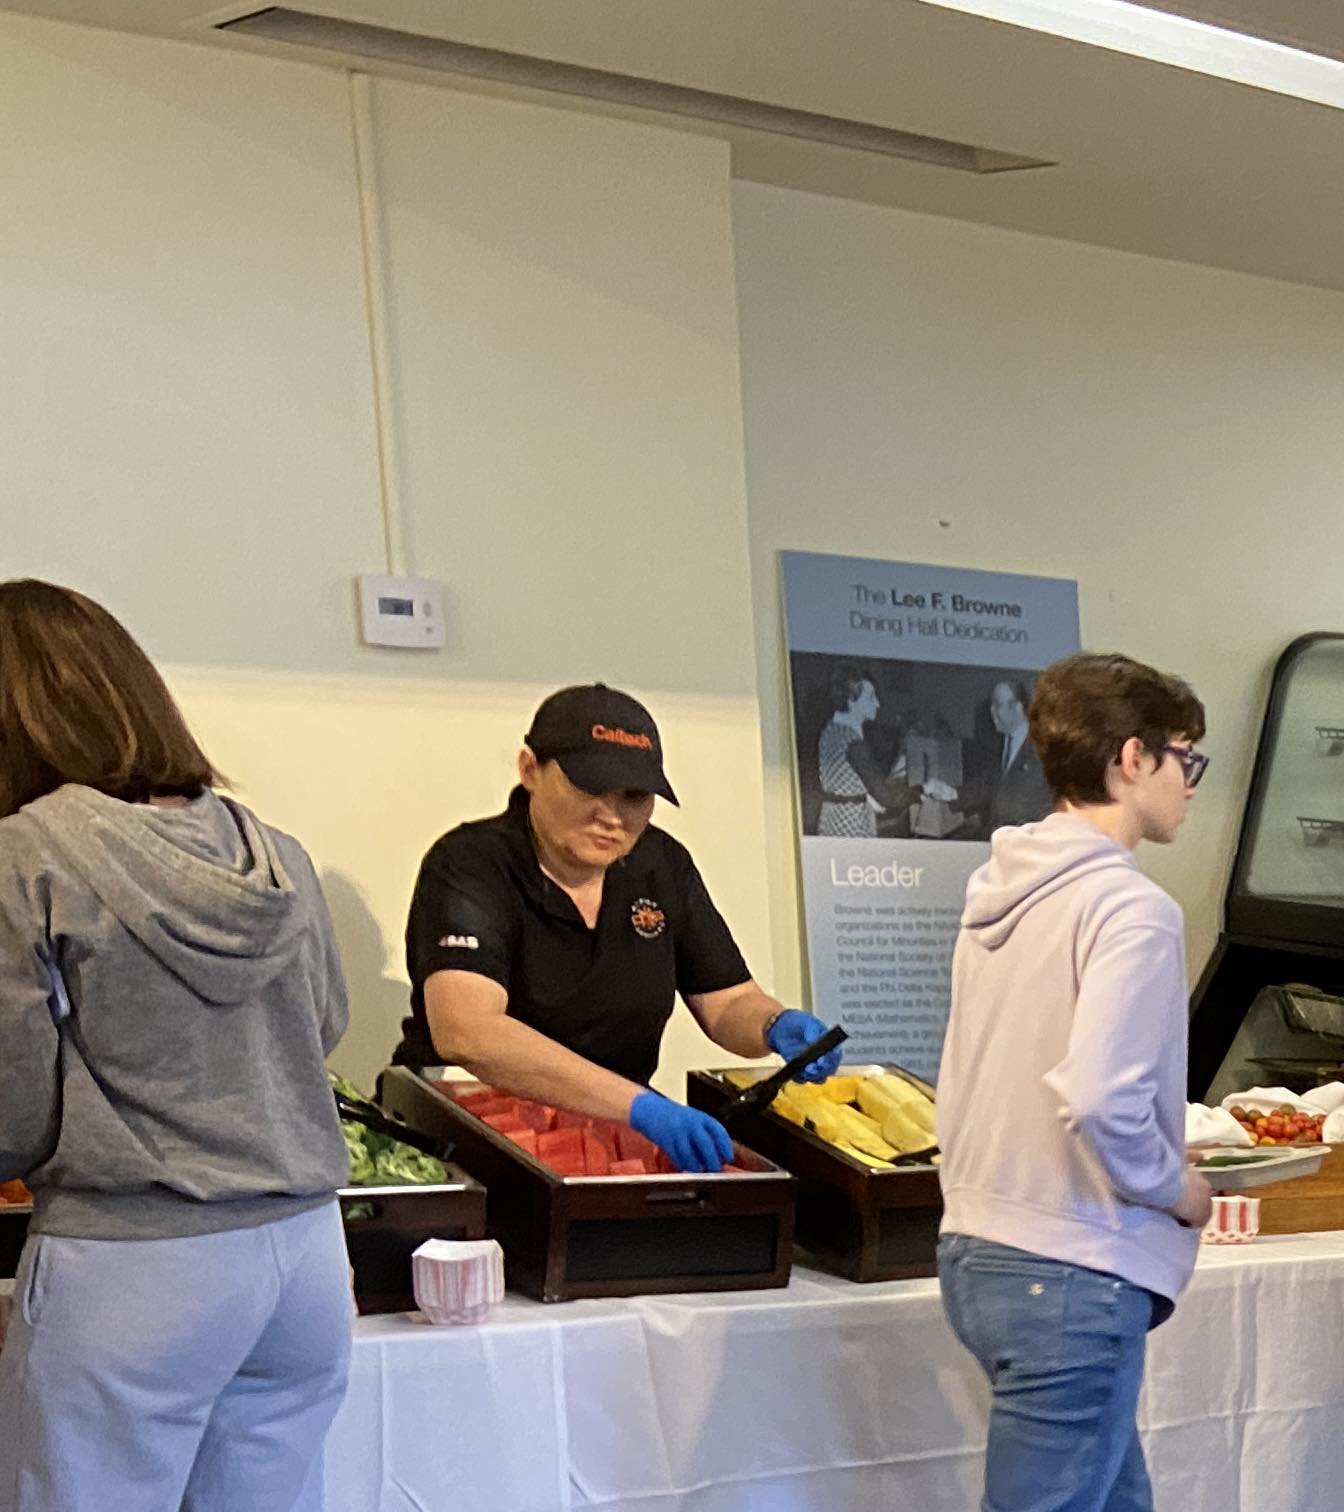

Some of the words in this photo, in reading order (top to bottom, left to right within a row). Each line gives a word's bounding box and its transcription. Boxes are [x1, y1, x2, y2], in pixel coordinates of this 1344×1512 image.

[853, 584, 886, 605] The
[891, 589, 926, 609] Lee
[931, 592, 945, 610] F.
[951, 594, 1022, 618] Browne
[850, 610, 903, 637] Dining
[907, 615, 940, 637] Hall
[943, 619, 1028, 644] Dedication
[830, 858, 925, 888] Leader
